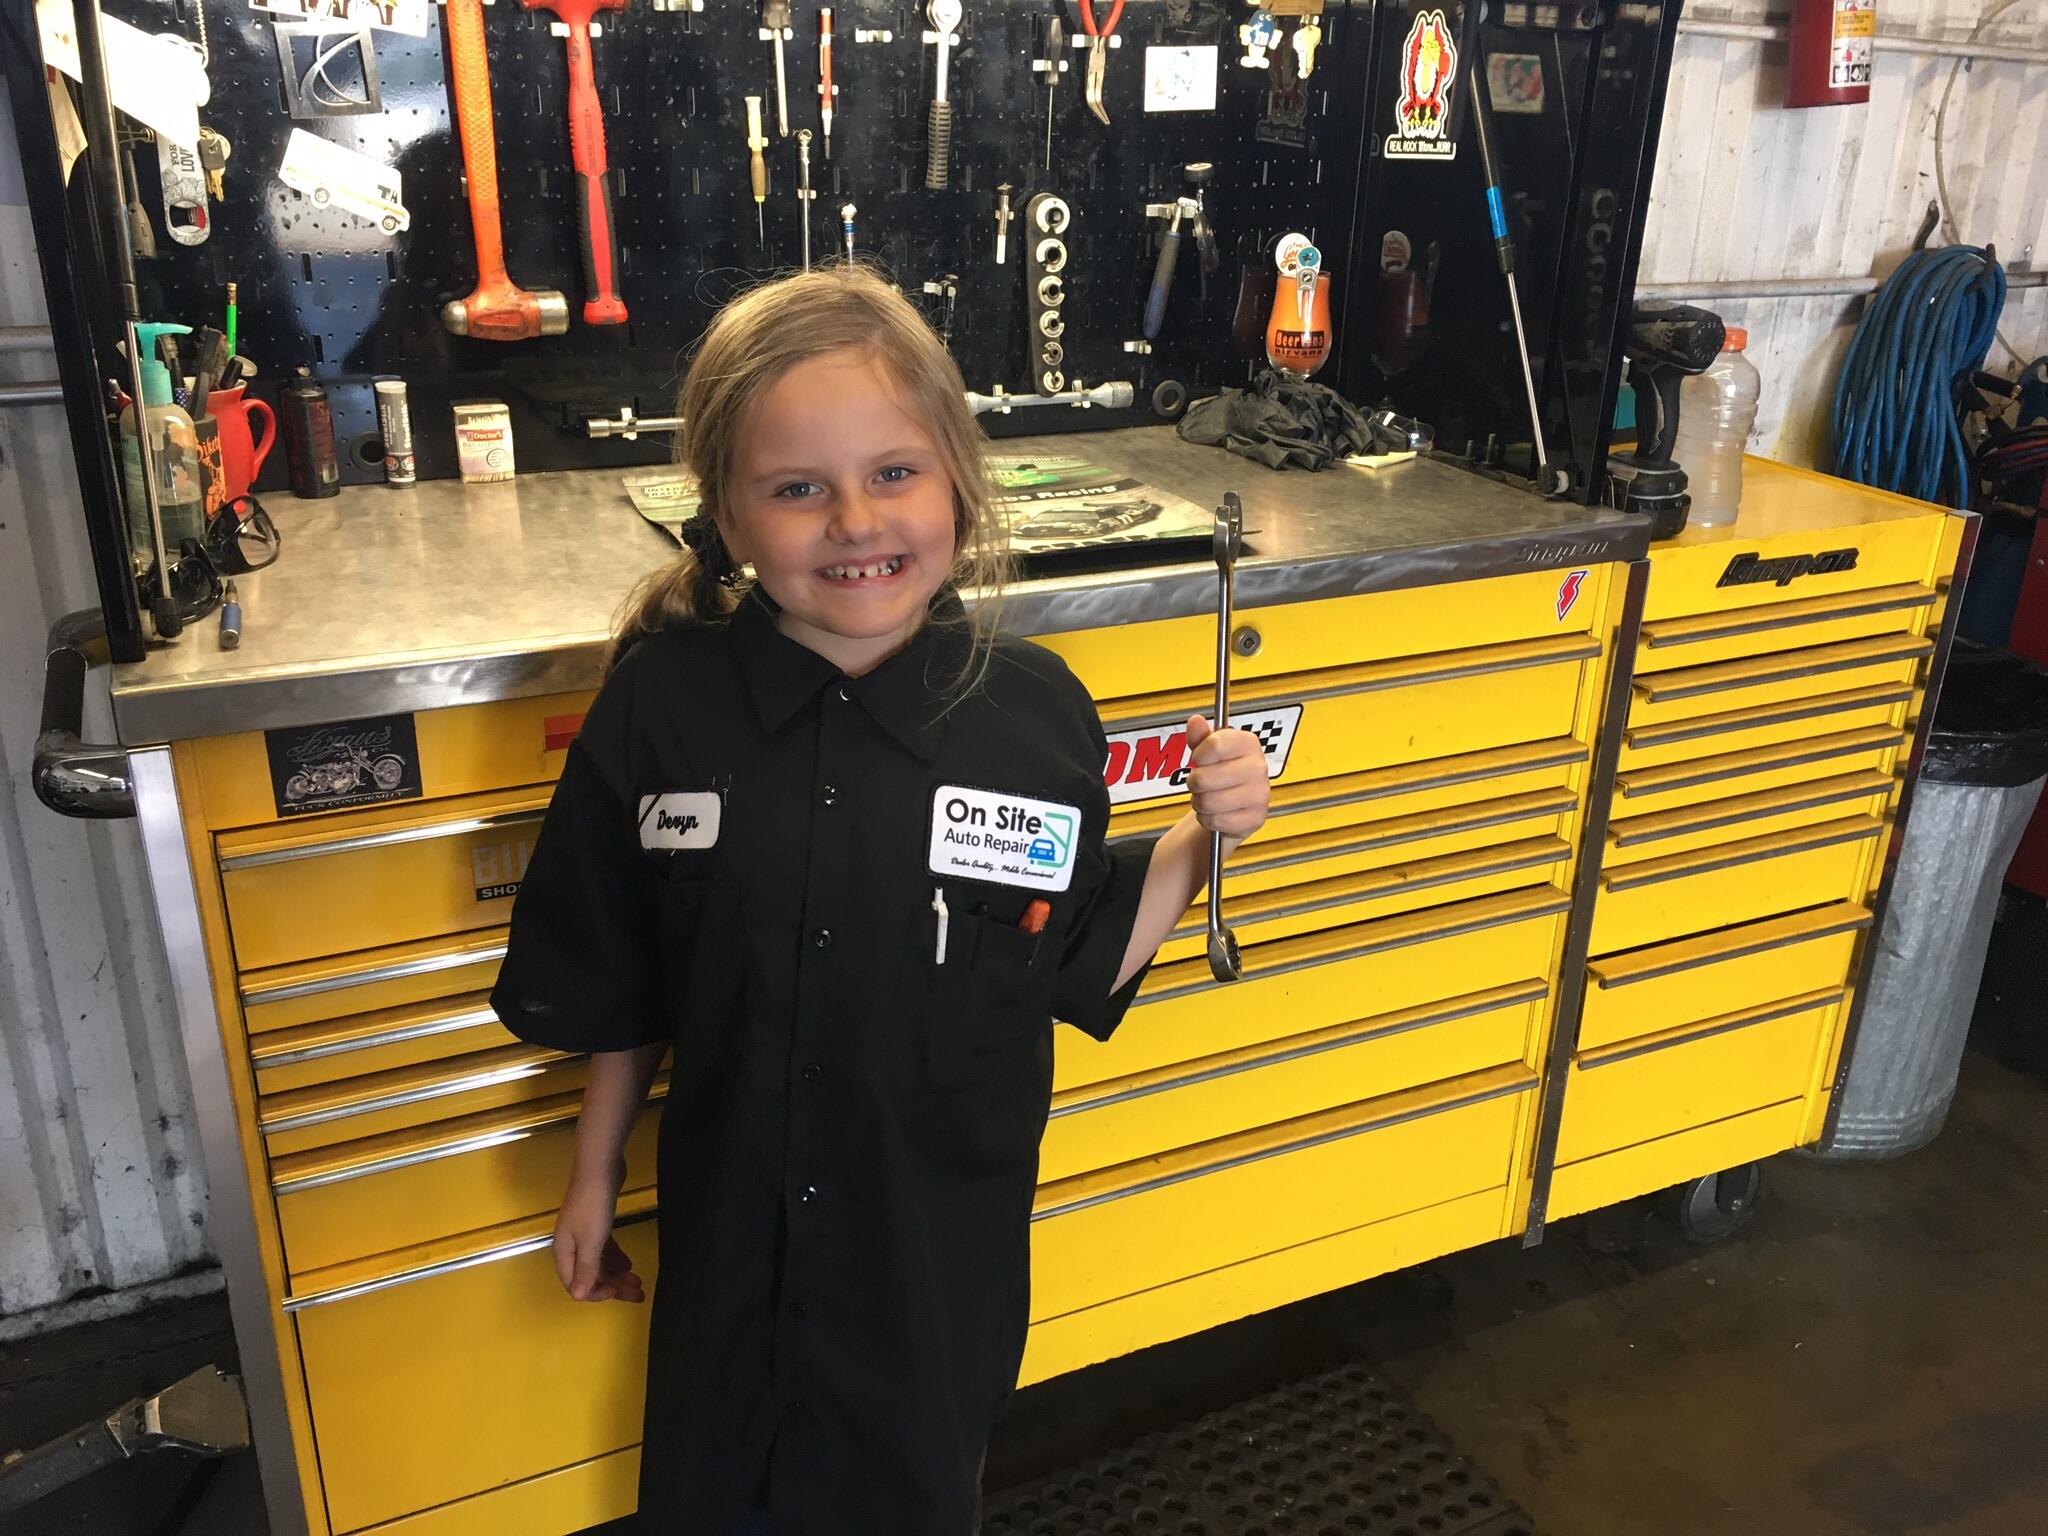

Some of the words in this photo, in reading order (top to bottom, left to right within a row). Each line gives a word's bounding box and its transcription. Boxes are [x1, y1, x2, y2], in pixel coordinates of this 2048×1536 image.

[1036, 485, 1117, 499] Racing
[946, 798, 986, 826] On
[995, 804, 1042, 835] Site
[943, 827, 980, 847] Auto
[984, 833, 1030, 855] Repair
